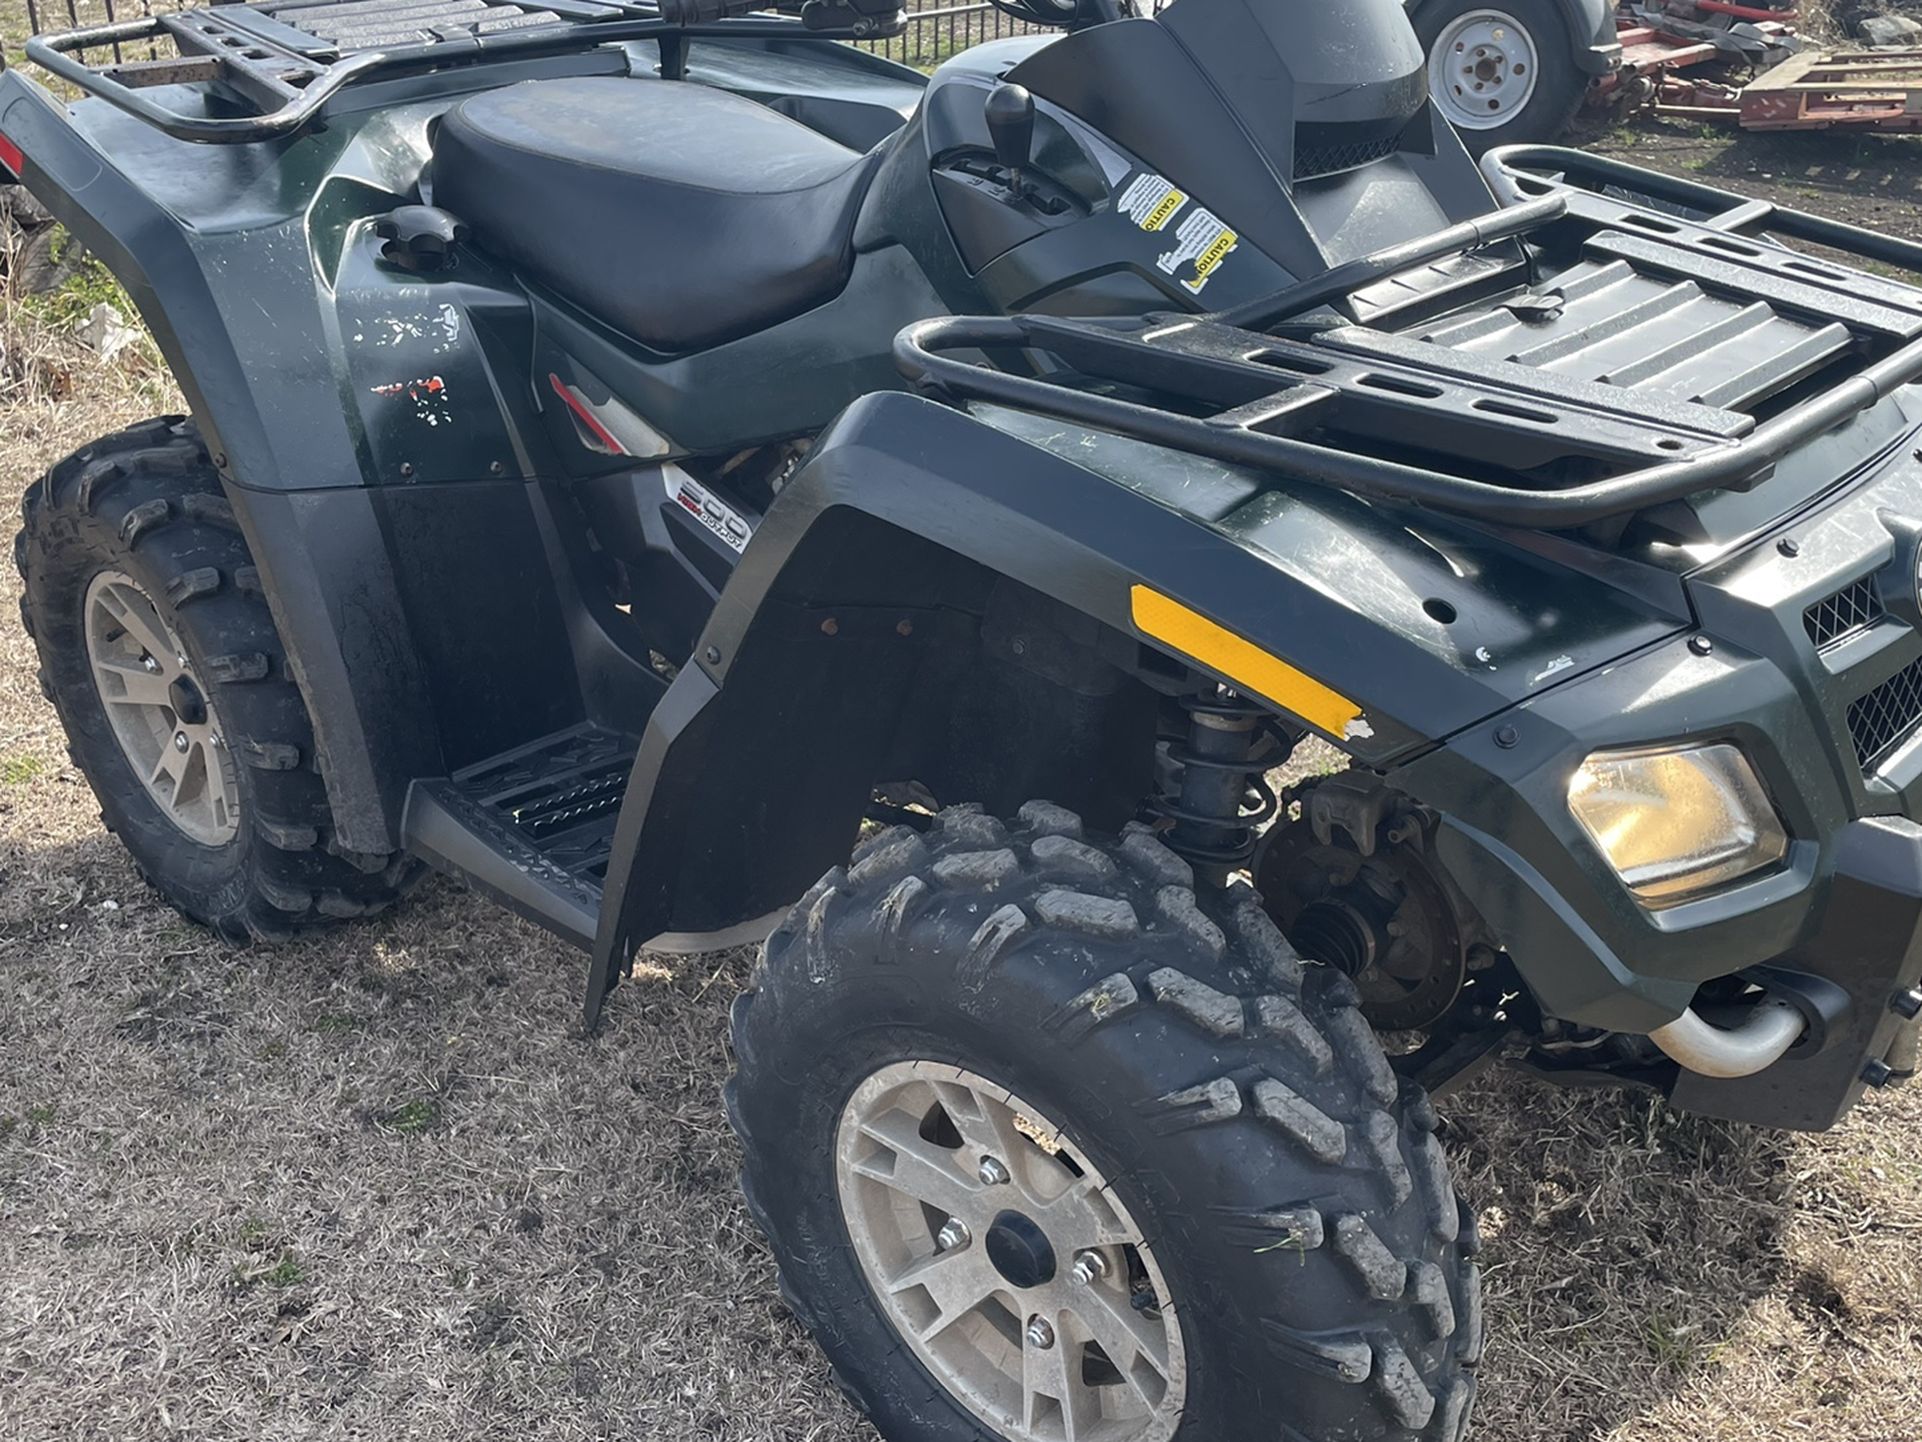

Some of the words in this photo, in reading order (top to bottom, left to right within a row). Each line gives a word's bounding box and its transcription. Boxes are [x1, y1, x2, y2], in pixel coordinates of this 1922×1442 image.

[1144, 197, 1176, 231] CAUTIO
[680, 480, 747, 540] 500
[700, 511, 742, 548] OUTPUT
